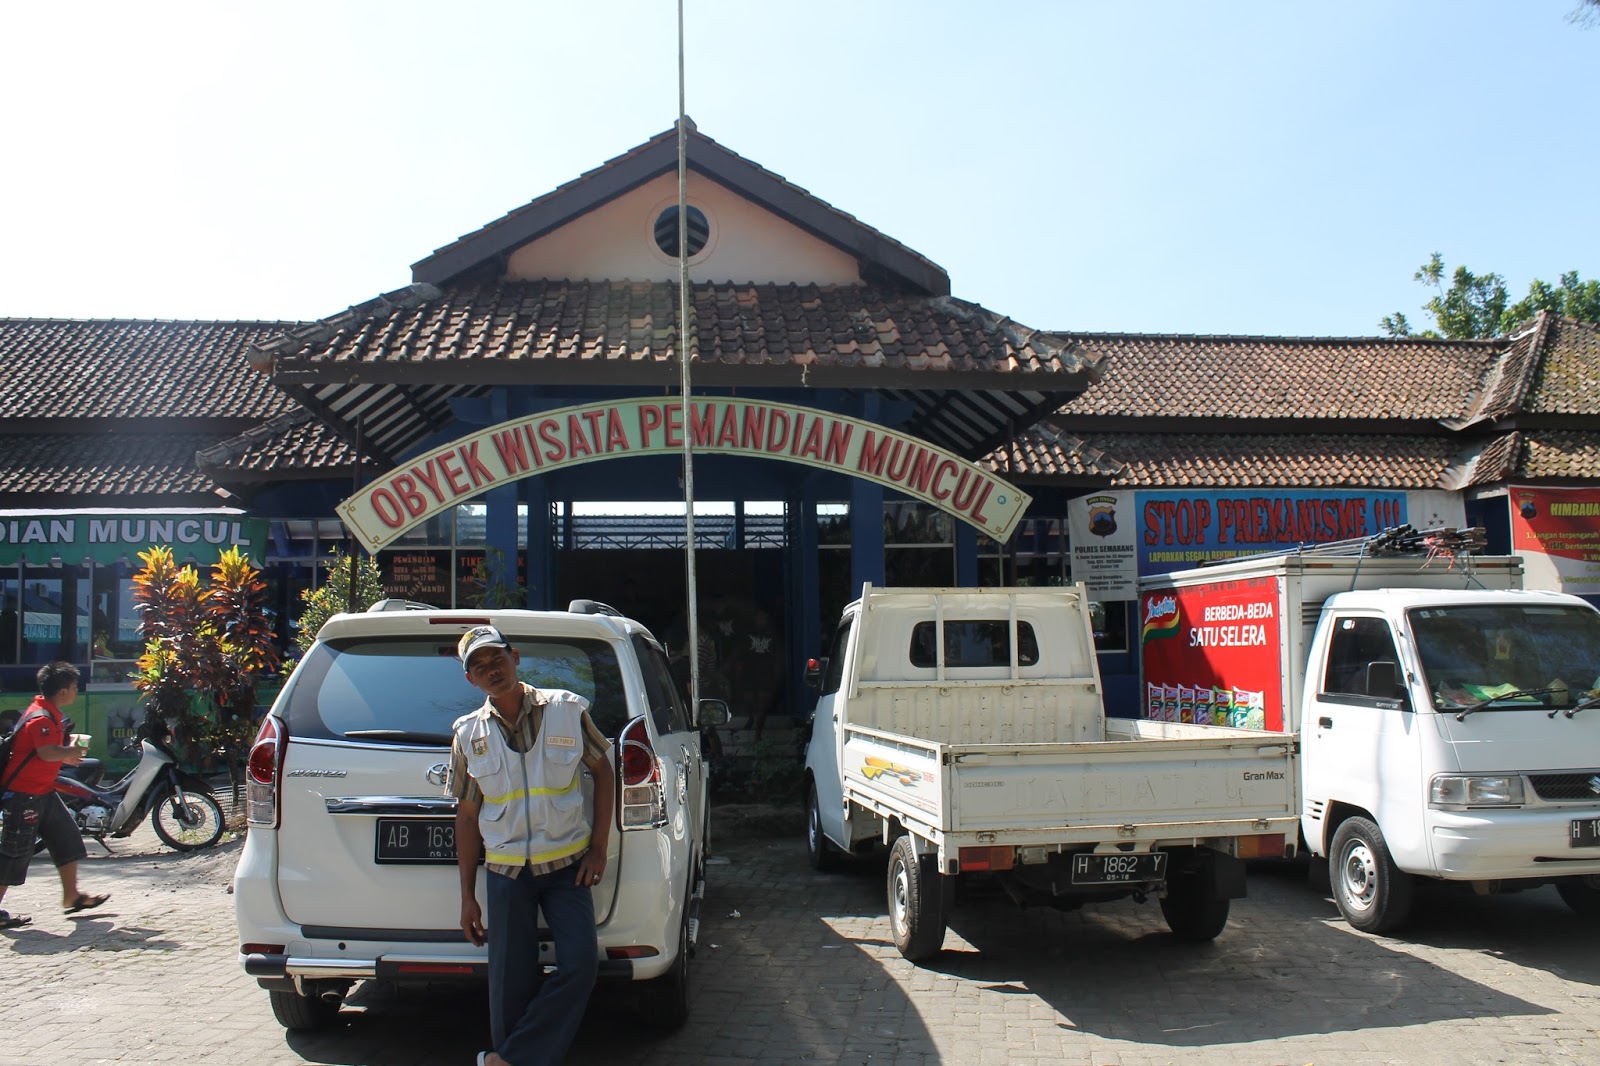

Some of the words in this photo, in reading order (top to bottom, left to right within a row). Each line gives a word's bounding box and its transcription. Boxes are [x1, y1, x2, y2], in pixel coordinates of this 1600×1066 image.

[369, 440, 496, 529] OBYEK
[491, 407, 631, 477] WISATA
[639, 403, 854, 466] PEMANDIAN
[858, 429, 996, 525] MUNCUL
[1144, 498, 1211, 546] STOP
[1217, 497, 1368, 543] PREMANISME
[0, 519, 75, 543] IAN
[88, 518, 250, 546] MUNCUL
[1533, 532, 1557, 540] Jangan
[1074, 546, 1099, 554] POLRES
[1099, 545, 1134, 553] SEMARANG
[1148, 551, 1185, 562] LAPORKAN
[1185, 550, 1211, 561] SEGALA
[421, 585, 445, 593] MANDI
[1204, 602, 1274, 622] BERBEDA-BEDA
[1189, 626, 1219, 647] SATU
[1219, 625, 1266, 646] SELERA
[287, 769, 348, 778] AVANZA
[1243, 771, 1265, 781] Gran
[1266, 771, 1285, 780] Max
[387, 825, 409, 848] AB
[1572, 821, 1580, 838] H
[1078, 857, 1089, 874] H
[1103, 856, 1138, 873] 1862
[1153, 855, 1162, 872] Y
